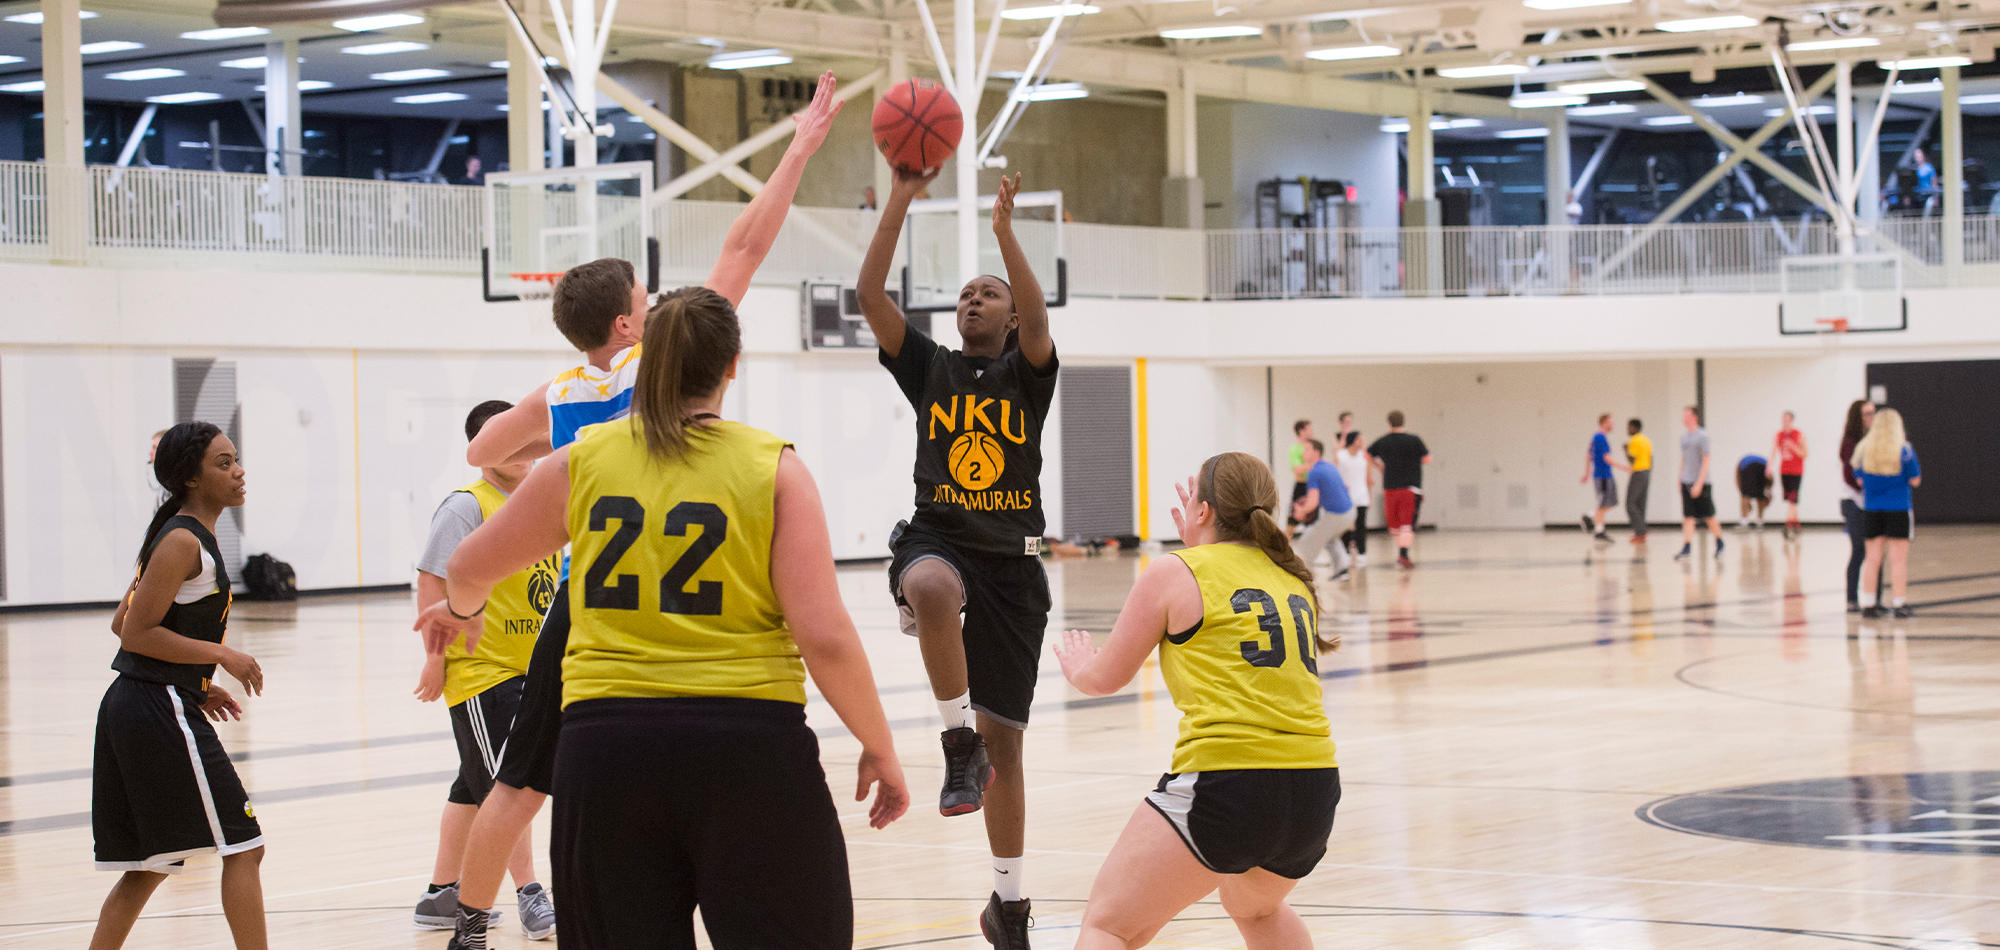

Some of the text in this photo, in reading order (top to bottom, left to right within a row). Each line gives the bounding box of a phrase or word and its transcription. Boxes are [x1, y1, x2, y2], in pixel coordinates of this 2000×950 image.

[929, 394, 1026, 445] NKU
[969, 461, 981, 482] 2
[933, 484, 1032, 511] INTRAMURALS
[584, 495, 728, 616] 22
[505, 619, 547, 635] INTRA
[1230, 588, 1319, 678] 30
